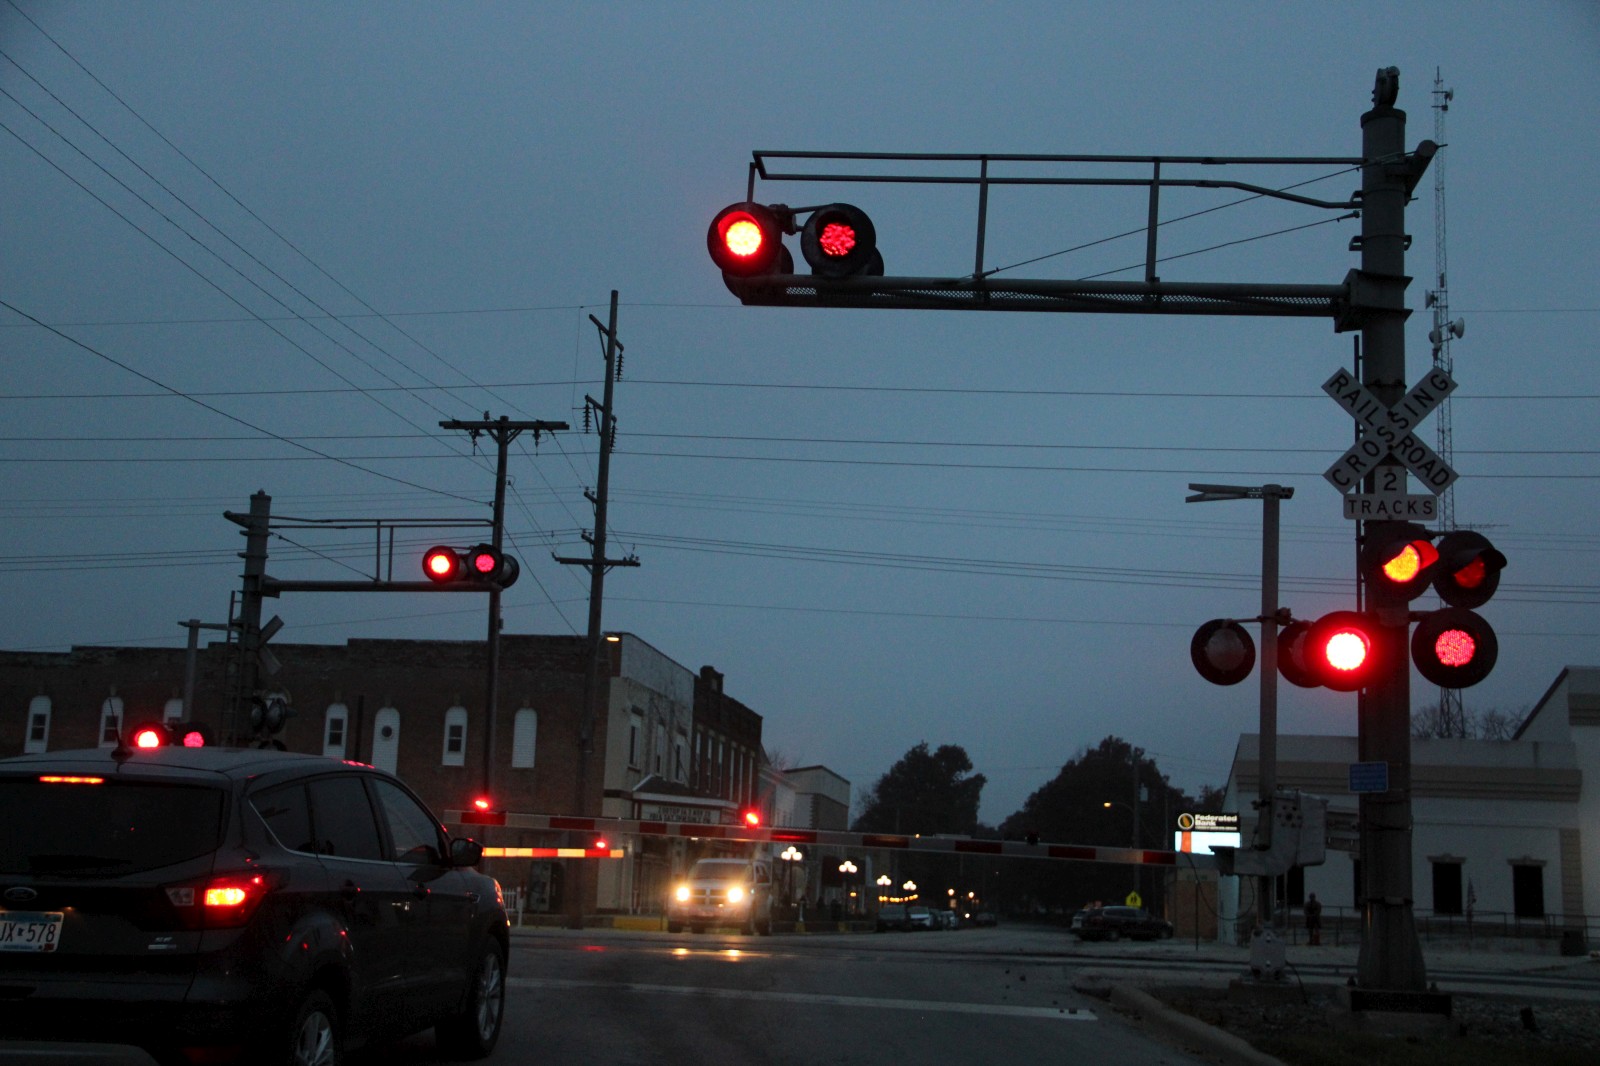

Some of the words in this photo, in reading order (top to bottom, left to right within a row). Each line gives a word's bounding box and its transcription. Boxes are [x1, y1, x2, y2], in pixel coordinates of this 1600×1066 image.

[1331, 373, 1449, 487] CROSSING
[1383, 472, 1398, 491] 2
[1348, 499, 1433, 515] TRACKS
[1195, 814, 1237, 822] Federated
[23, 922, 57, 942] 578
